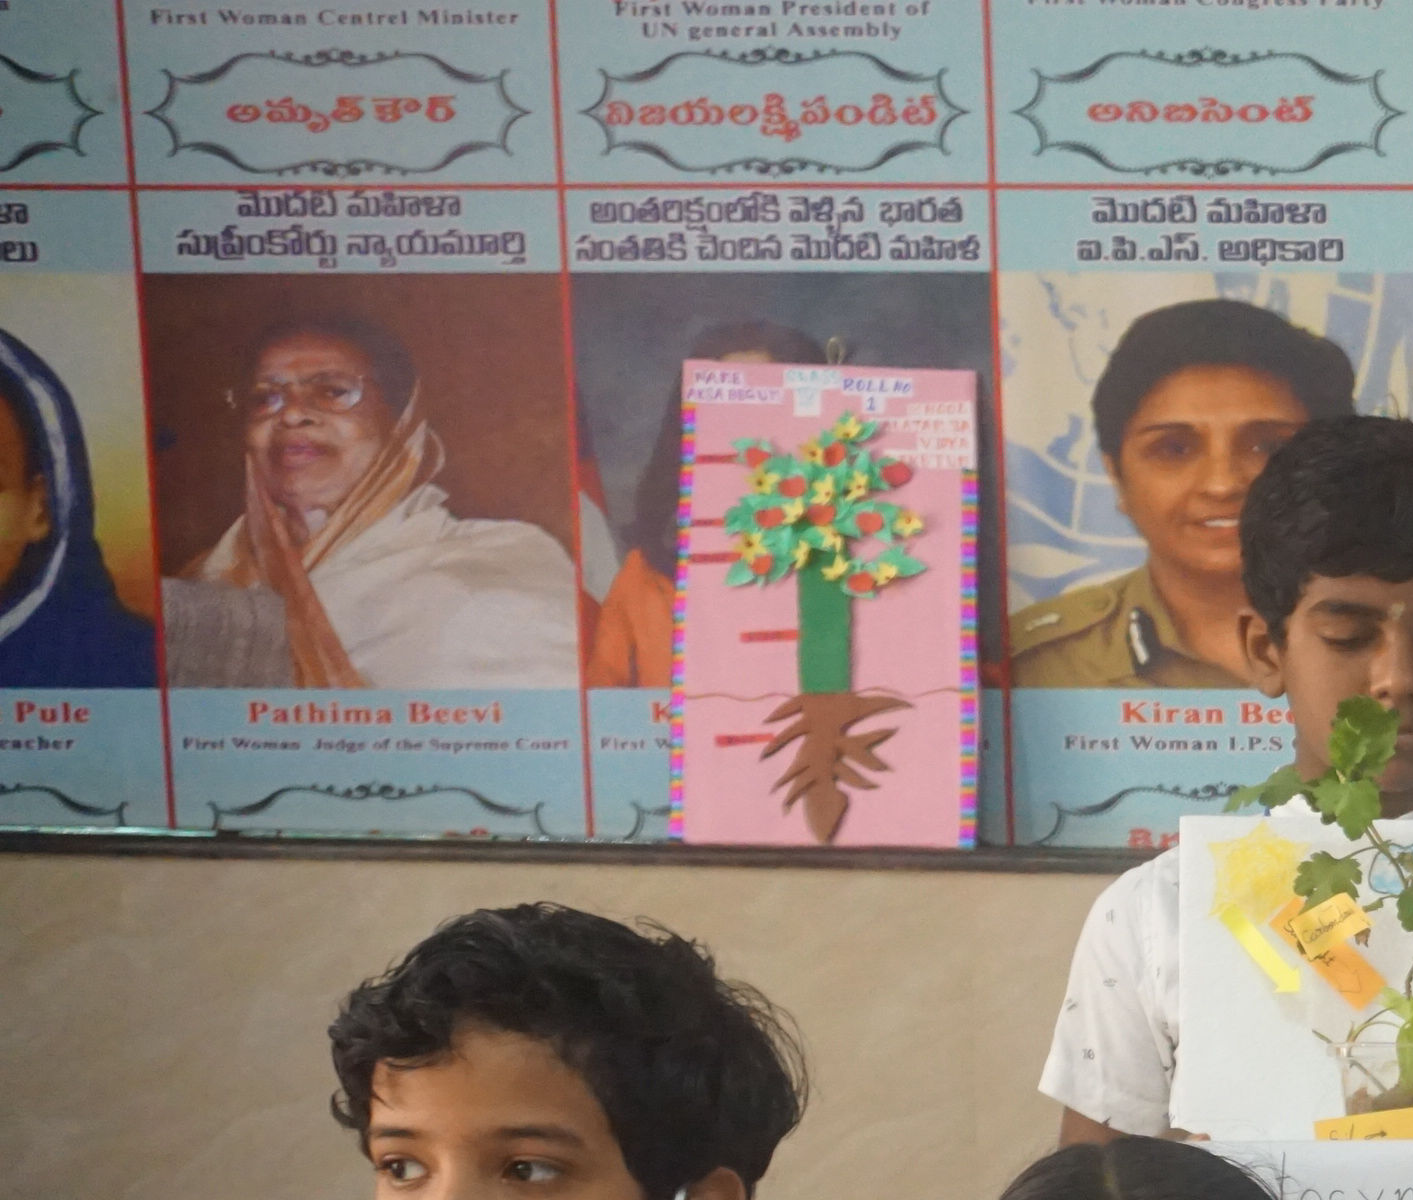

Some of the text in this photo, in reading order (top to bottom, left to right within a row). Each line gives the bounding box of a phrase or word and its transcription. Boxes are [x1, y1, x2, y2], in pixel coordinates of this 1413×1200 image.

[151, 9, 206, 26] First
[220, 9, 306, 26] Woman
[418, 10, 519, 26] Minister
[616, 0, 931, 16] First Woman President of
[642, 22, 901, 41] UN general Assembly
[237, 190, 461, 219] మొదటి మహిళా
[879, 197, 963, 228] భారత
[1092, 195, 1326, 225] మొదటి మహిళా
[791, 232, 880, 262] మొదటి
[889, 236, 979, 262] మహిళ
[15, 701, 90, 724] Pule
[248, 701, 504, 725] Pathima Beevi
[1122, 702, 1296, 726] Kiran Be
[0, 736, 74, 750] eacher
[182, 737, 225, 751] First
[232, 737, 300, 751] Woman
[312, 737, 365, 753] Judge
[371, 736, 391, 751] of
[430, 737, 510, 754] Supreme
[516, 737, 568, 751] Court
[601, 736, 646, 750] First
[1064, 735, 1119, 751] First
[1130, 735, 1218, 751] Woman
[1229, 735, 1283, 751] I.P.S
